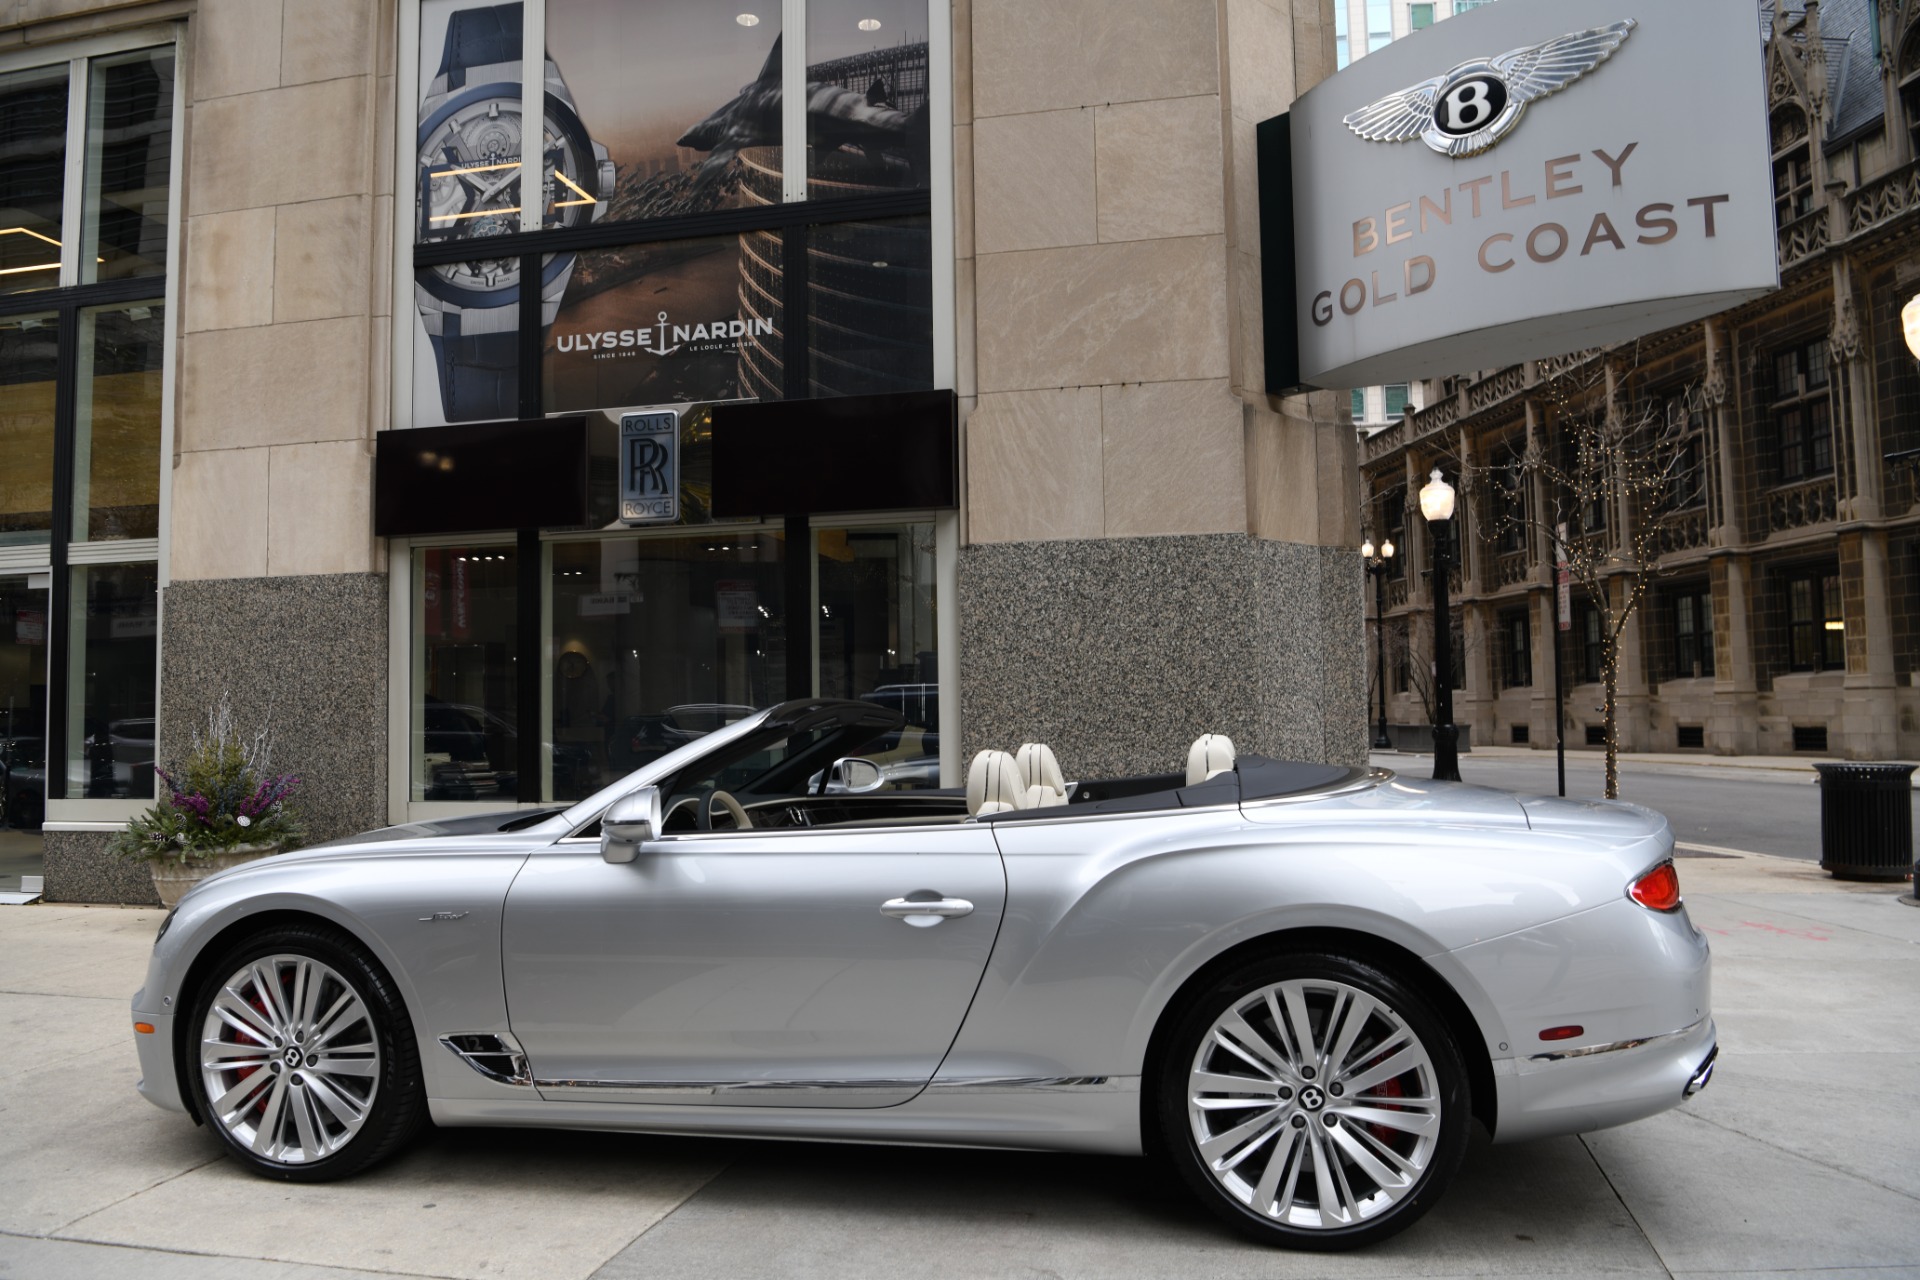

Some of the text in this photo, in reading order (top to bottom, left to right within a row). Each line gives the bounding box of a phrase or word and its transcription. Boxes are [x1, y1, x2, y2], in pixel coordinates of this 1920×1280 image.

[496, 156, 521, 165] NARDI
[1352, 141, 1639, 258] BENTLEY
[1311, 193, 1730, 328] GOLD COAST
[557, 317, 773, 353] ULYSSE NARDIN
[700, 343, 723, 351] LOCLE
[593, 352, 616, 360] SINCE
[625, 417, 671, 432] ROLLS
[625, 501, 671, 516] ROYCE
